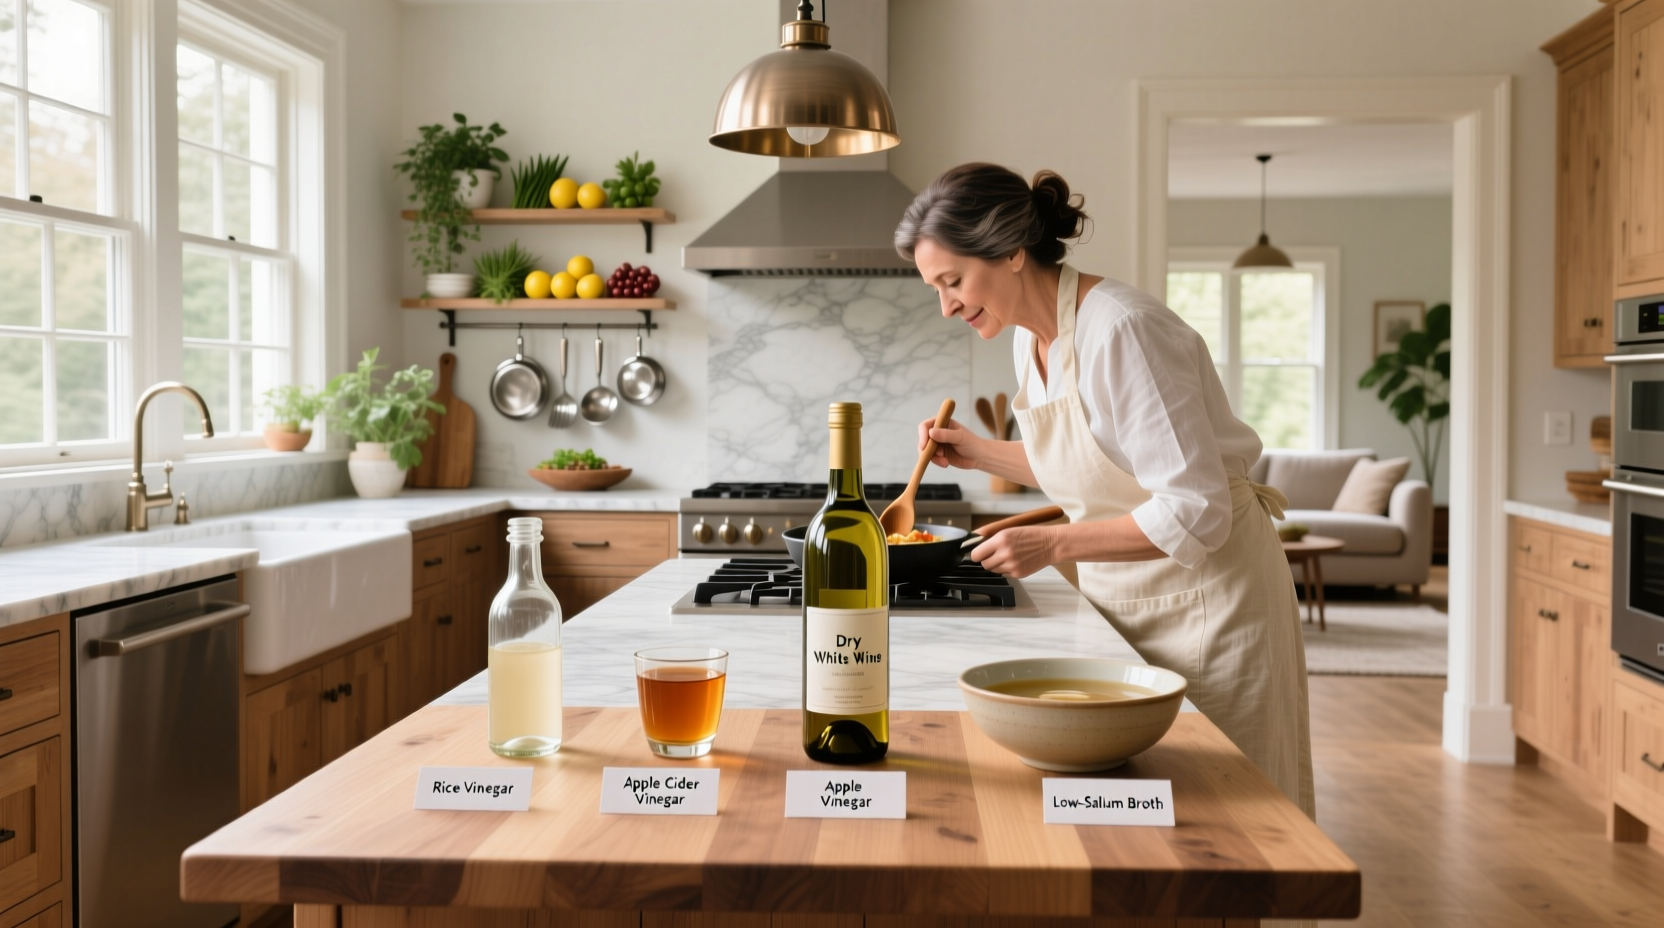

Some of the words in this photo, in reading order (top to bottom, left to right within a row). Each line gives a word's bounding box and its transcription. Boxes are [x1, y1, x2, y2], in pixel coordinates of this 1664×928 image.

[836, 634, 862, 650] Dry
[432, 781, 460, 793] Rice
[464, 781, 514, 798] Vinegar
[623, 776, 660, 793] Apple
[665, 776, 700, 789] Cider
[825, 780, 862, 796] Apple
[634, 793, 685, 808] Vinegar
[820, 796, 872, 810] Vinegar
[1128, 797, 1163, 809] Broth
